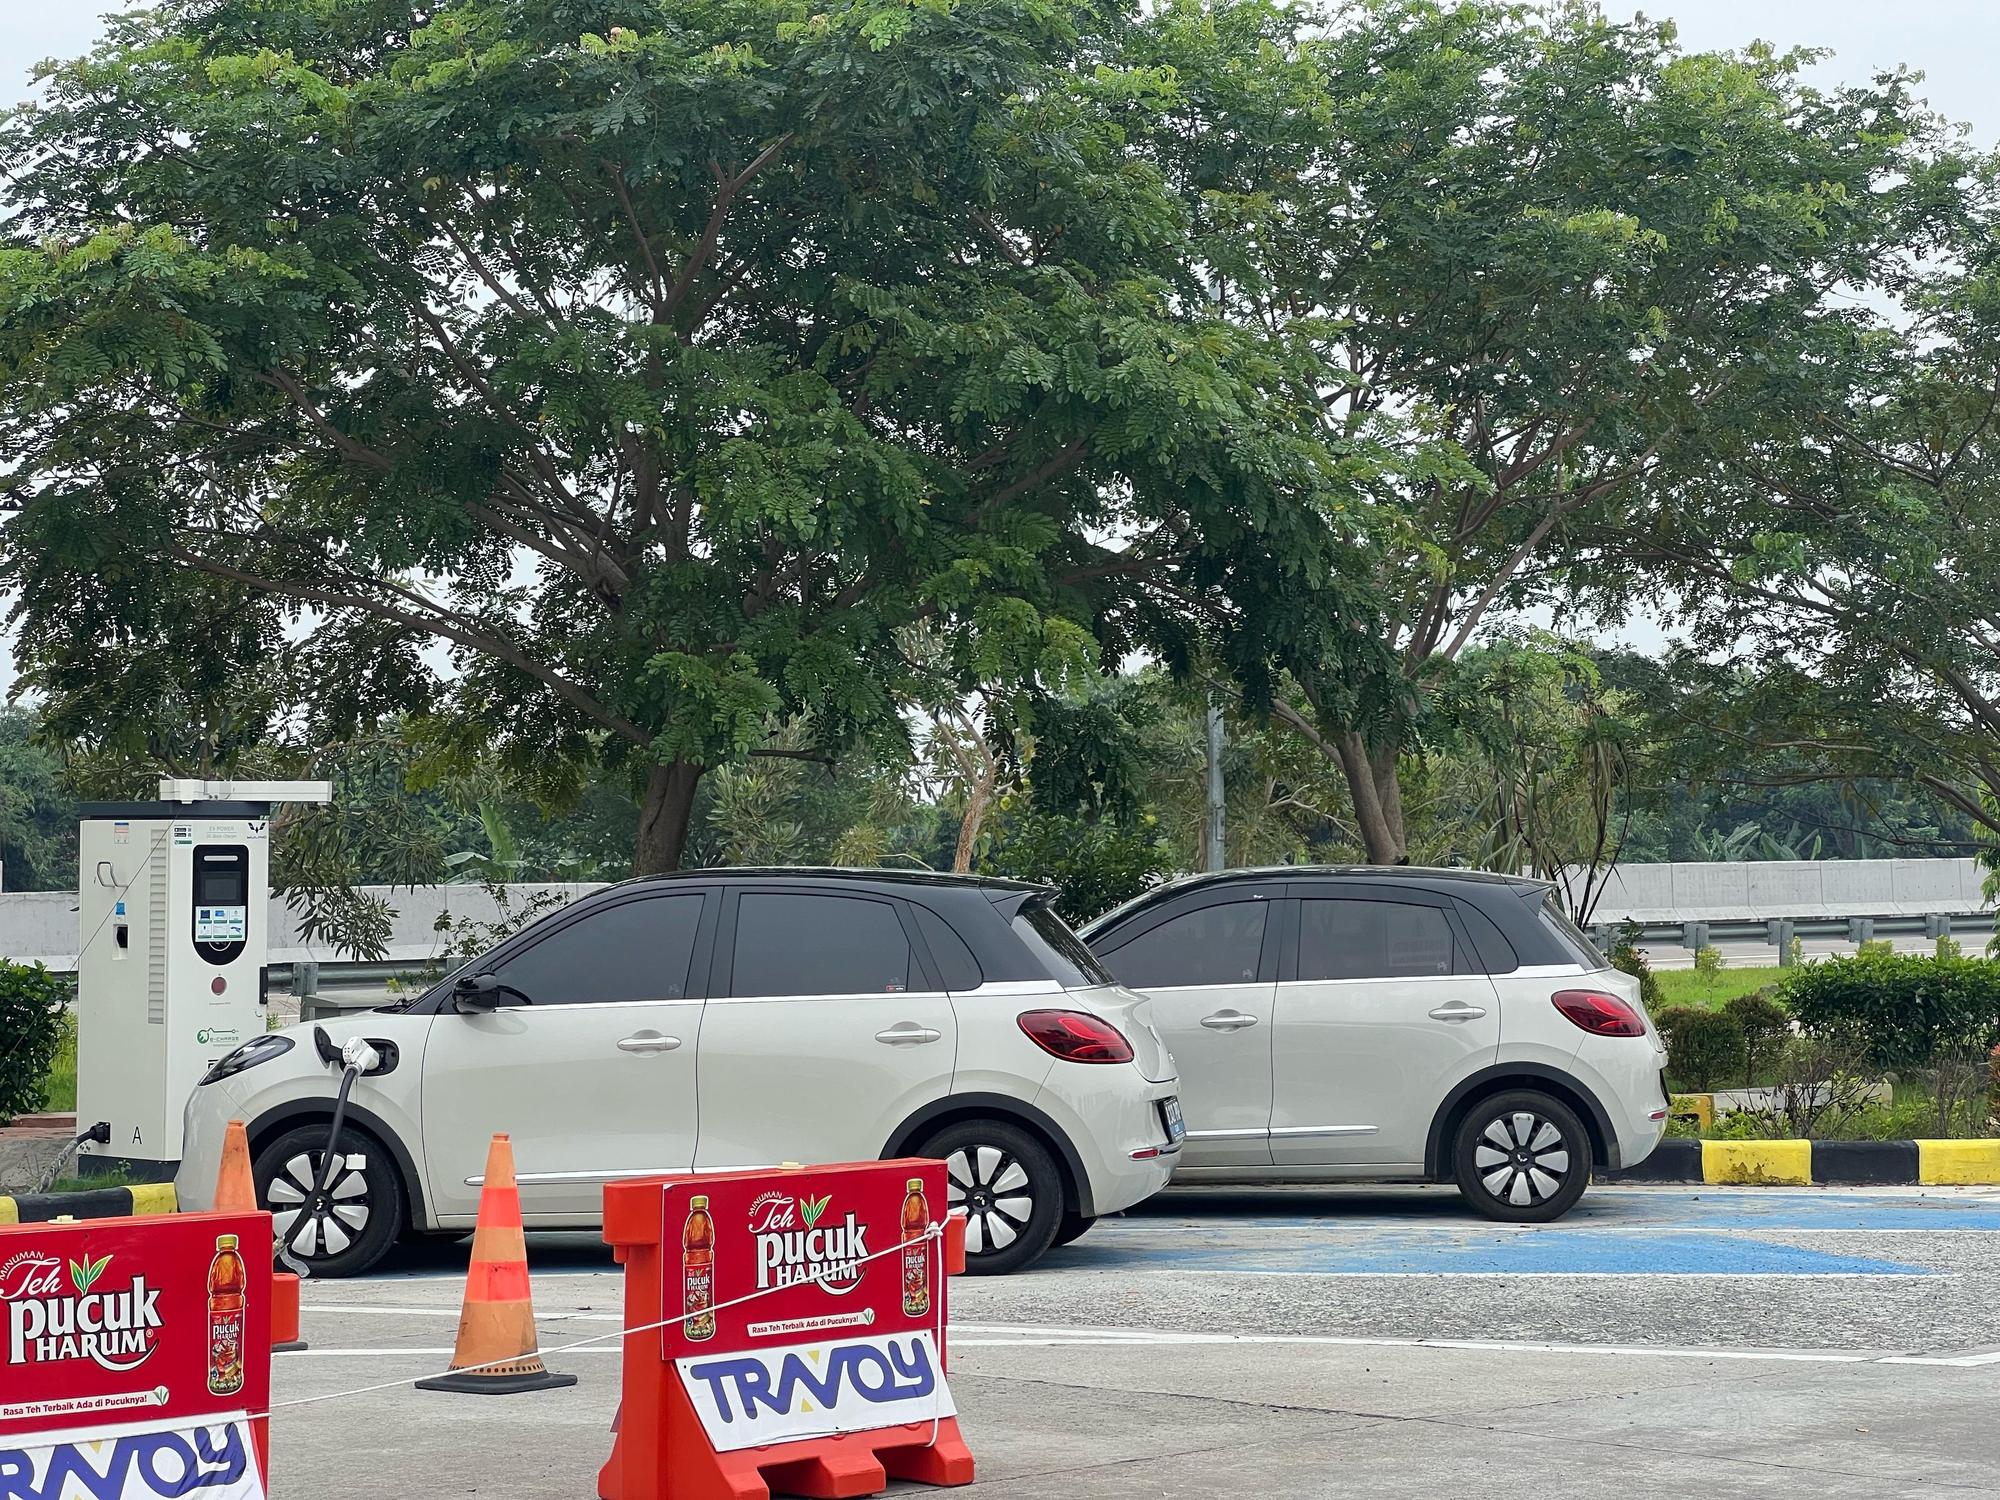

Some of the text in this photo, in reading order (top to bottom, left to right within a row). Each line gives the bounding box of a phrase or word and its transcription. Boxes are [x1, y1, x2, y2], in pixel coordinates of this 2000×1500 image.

[132, 1126, 142, 1145] A
[748, 1190, 783, 1217] MINUMAN
[748, 1197, 795, 1233] Teh
[0, 1250, 45, 1281] MINUMAN
[756, 1213, 869, 1289] pucuk
[0, 1257, 63, 1300] Teh
[776, 1259, 866, 1295] HARUM
[9, 1276, 163, 1364] pucuk
[213, 1320, 240, 1340] pucuk
[752, 1315, 859, 1334] Rasa Teh Terbaik Ada di Pucuknya!
[36, 1328, 158, 1371] HARUM
[3, 1394, 147, 1416] Rasa Teh Terbaik Ada di Pucuknya!
